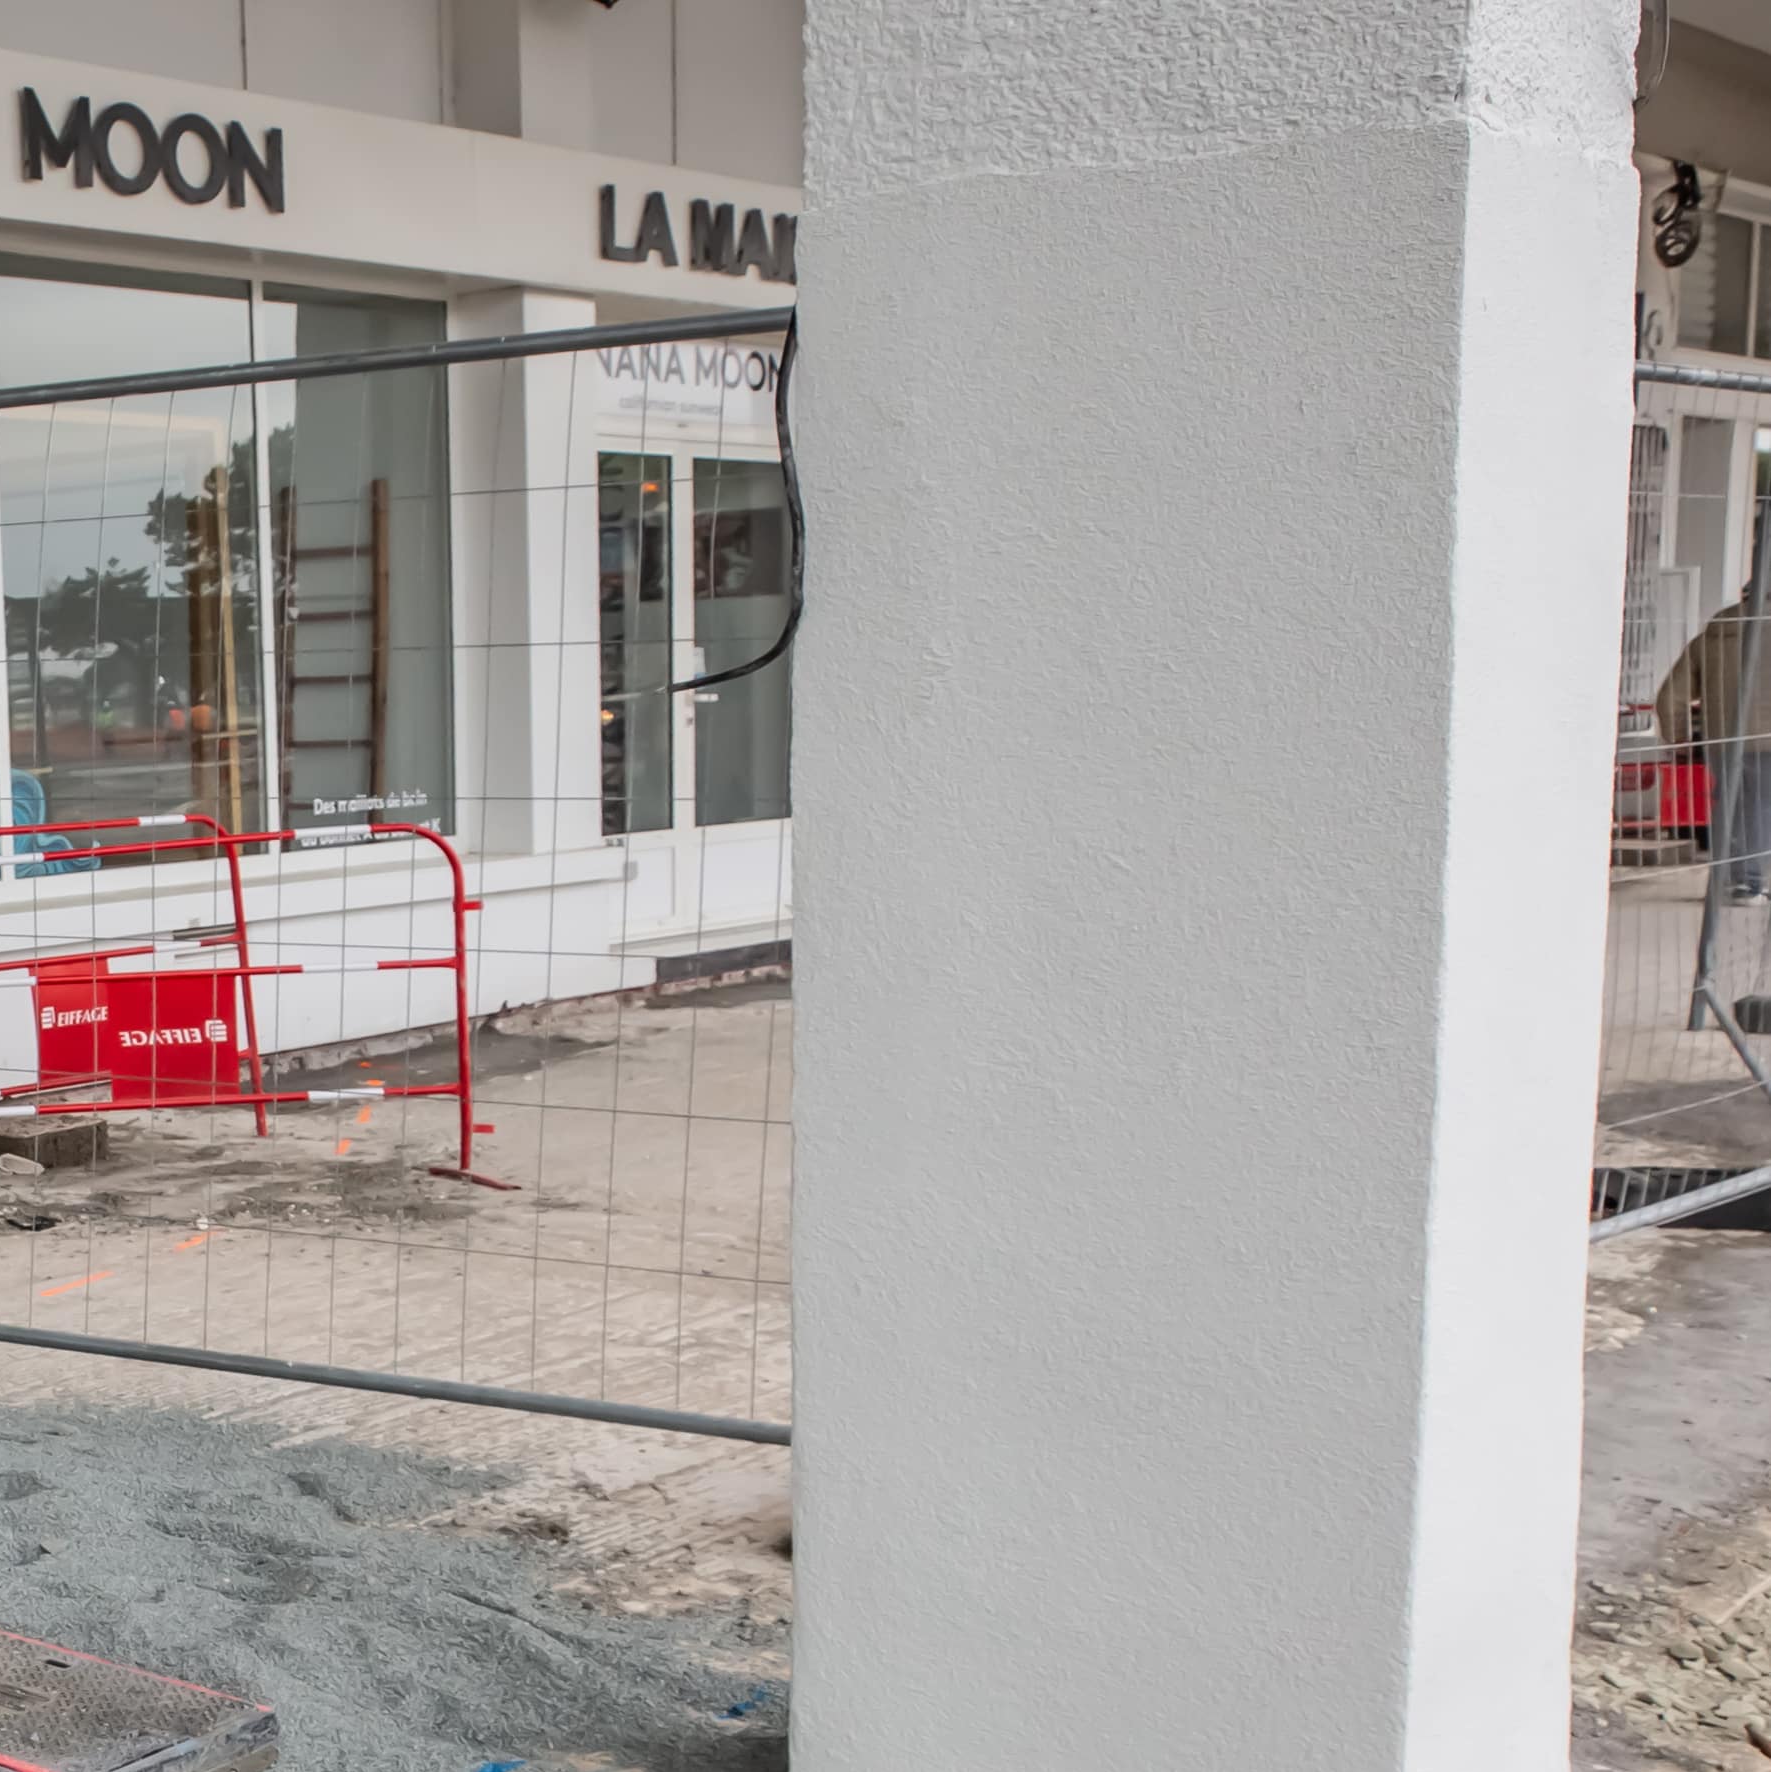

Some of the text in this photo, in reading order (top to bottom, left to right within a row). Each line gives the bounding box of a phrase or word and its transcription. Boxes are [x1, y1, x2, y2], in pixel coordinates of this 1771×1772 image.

[22, 86, 285, 213] MOON
[598, 183, 679, 268] LA
[313, 797, 336, 816] Des
[57, 1005, 108, 1028] EIFFAGE
